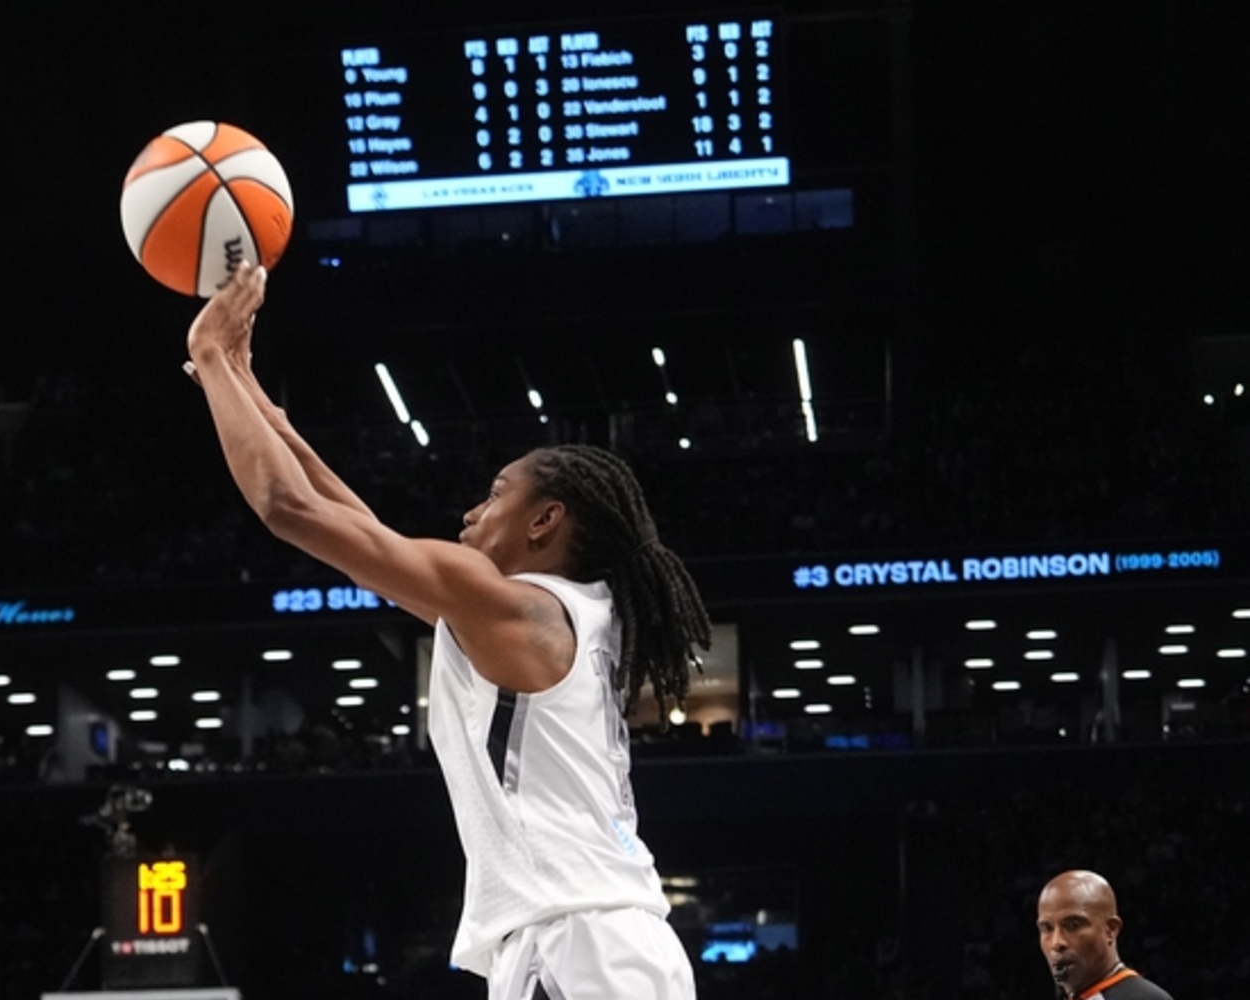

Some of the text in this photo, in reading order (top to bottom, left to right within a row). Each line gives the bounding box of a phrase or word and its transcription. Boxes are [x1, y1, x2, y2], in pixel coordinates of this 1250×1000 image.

[560, 54, 579, 69] 13
[691, 44, 706, 62] 3
[755, 40, 769, 57] 2
[361, 67, 408, 84] Young
[504, 56, 516, 73] 1
[535, 54, 547, 71] 1
[693, 68, 707, 85] 9
[727, 66, 739, 83] 1
[756, 63, 770, 80] 2
[364, 91, 402, 107] Plum
[504, 80, 519, 98] 0
[535, 78, 549, 96] 3
[696, 92, 707, 108] 1
[728, 90, 740, 106] 1
[758, 87, 771, 104] 2
[365, 114, 402, 132] Gray
[475, 106, 489, 123] 4
[507, 104, 519, 121] 1
[537, 102, 551, 119] 0
[728, 114, 741, 131] 3
[759, 111, 772, 129] 2
[476, 129, 491, 147] 0
[507, 127, 522, 145] 2
[538, 125, 553, 143] 0
[587, 146, 631, 161] Jones
[694, 139, 713, 156] 11
[729, 137, 742, 154] 4
[761, 136, 773, 152] 1
[369, 159, 419, 175] Wilson
[509, 150, 523, 168] 2
[540, 148, 554, 166] 2
[793, 550, 1220, 588] #3 CRYSTAL ROBINSON (1999-2005)
[272, 588, 323, 612] #23
[326, 586, 380, 610] SUE
[138, 889, 181, 934] 10
